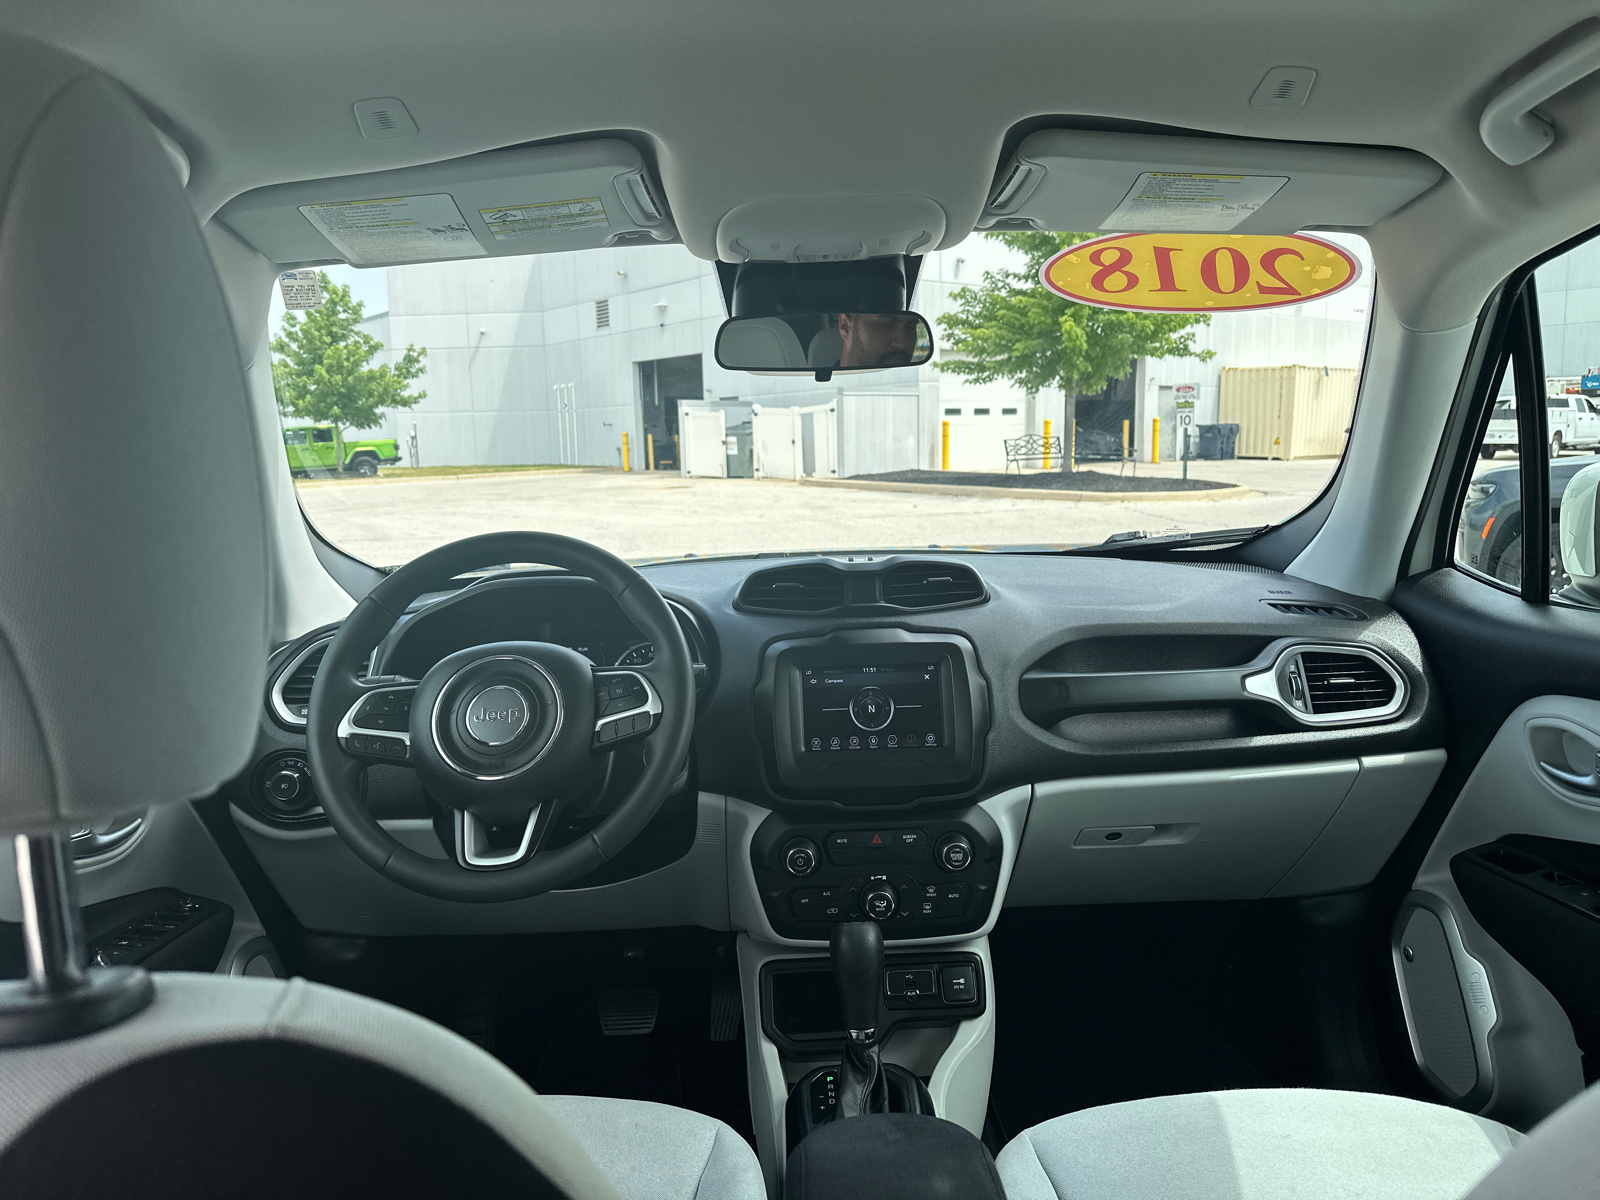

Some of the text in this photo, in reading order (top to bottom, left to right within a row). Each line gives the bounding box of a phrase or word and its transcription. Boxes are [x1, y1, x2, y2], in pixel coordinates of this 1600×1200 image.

[1180, 414, 1192, 426] 10
[473, 706, 521, 723] Jeep
[867, 704, 876, 713] N
